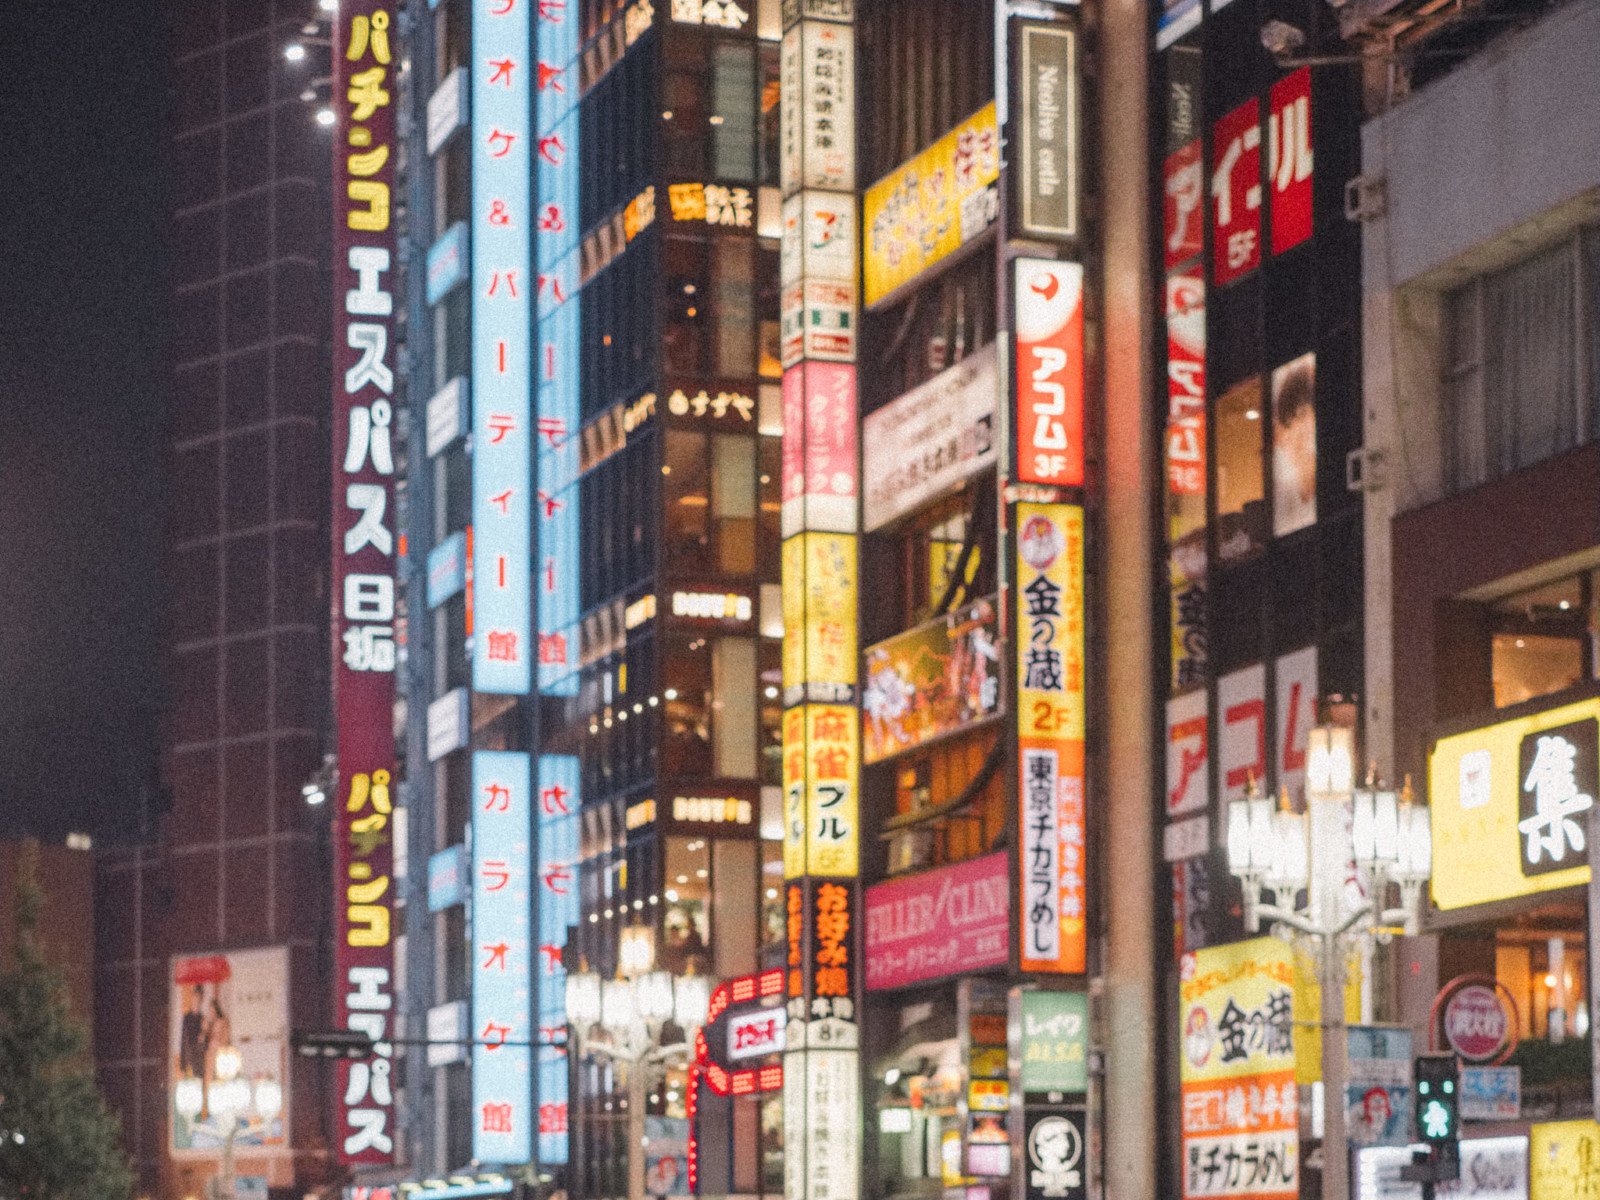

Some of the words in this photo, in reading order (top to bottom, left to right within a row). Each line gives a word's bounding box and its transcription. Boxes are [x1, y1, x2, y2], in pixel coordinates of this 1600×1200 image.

[346, 10, 391, 231] パチンコ
[1032, 346, 1067, 449] アコム
[1034, 454, 1067, 478] 3F
[1025, 574, 1062, 691] 金の蔵
[1033, 701, 1070, 731] 2F
[347, 769, 391, 946] パチンコ
[1028, 756, 1054, 952] 東京チカラめし
[481, 784, 513, 1133] カラオケ館
